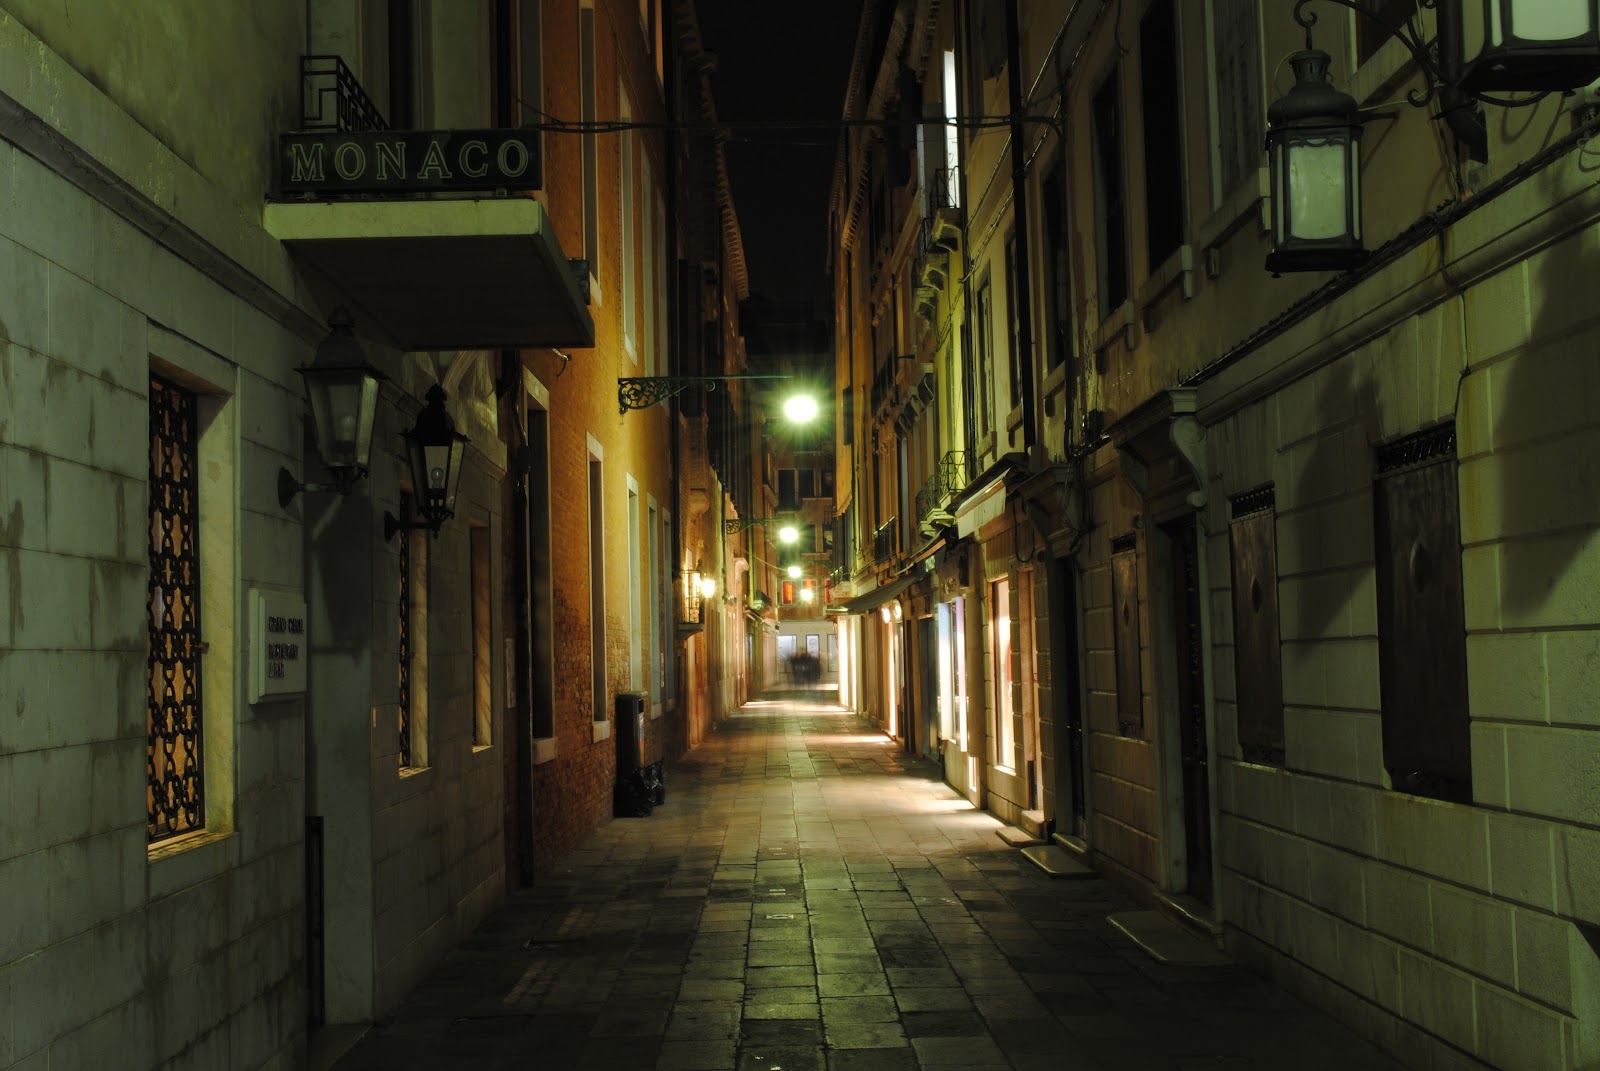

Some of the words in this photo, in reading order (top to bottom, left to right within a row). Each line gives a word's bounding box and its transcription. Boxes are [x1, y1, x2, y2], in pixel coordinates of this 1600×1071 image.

[290, 139, 530, 182] MONACO
[268, 616, 287, 633] GRAND
[288, 617, 305, 635] CANAL
